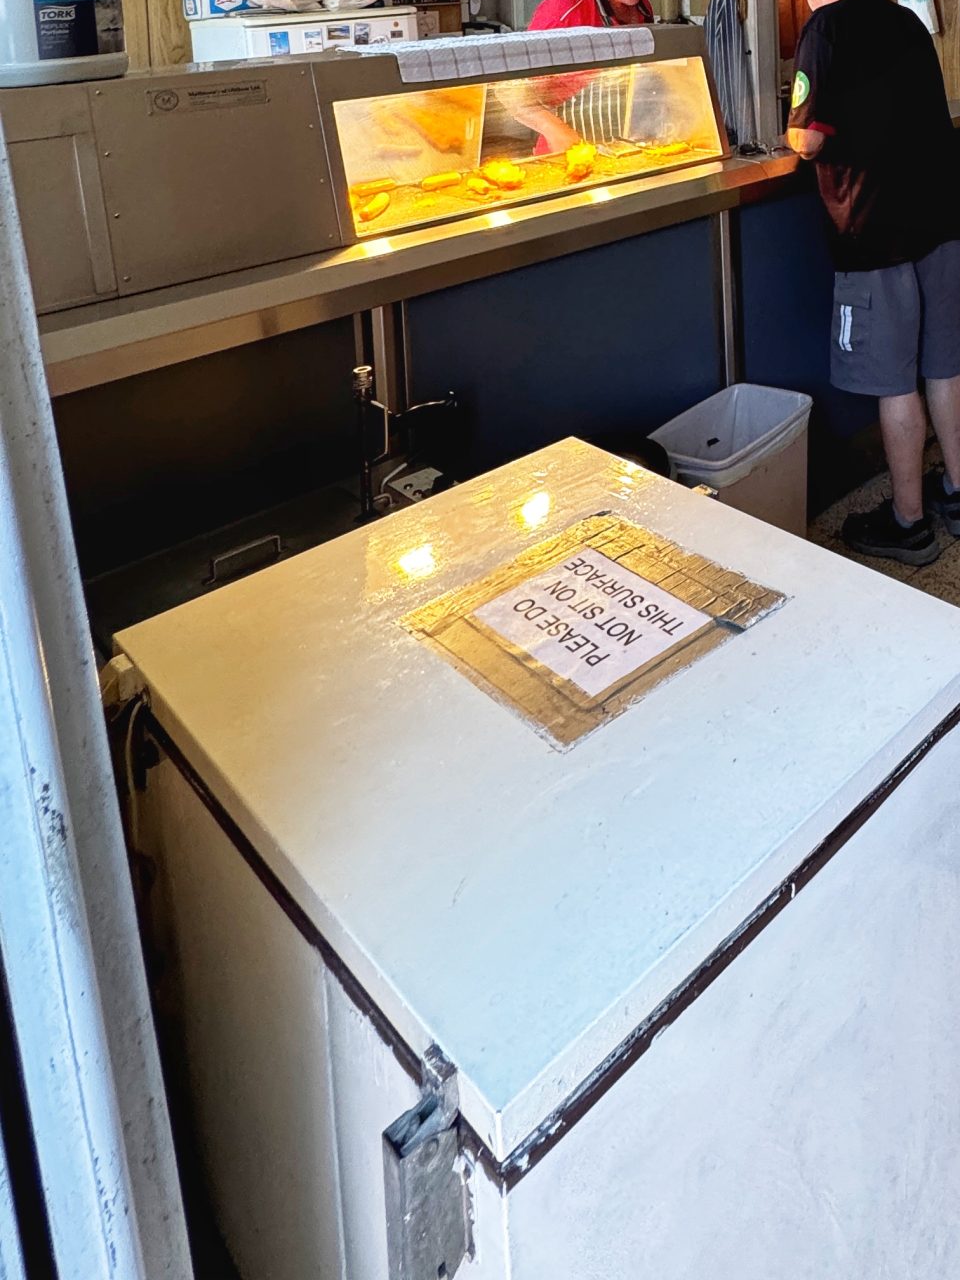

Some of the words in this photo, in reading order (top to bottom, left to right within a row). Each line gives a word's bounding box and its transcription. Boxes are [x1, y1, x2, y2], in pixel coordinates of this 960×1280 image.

[41, 10, 74, 20] TORK
[543, 579, 579, 602] ON
[563, 557, 646, 609] SURFACE
[513, 598, 547, 621] DO
[567, 598, 604, 620] SIT
[637, 603, 685, 637] THIS
[535, 614, 612, 667] PLEASE
[593, 617, 643, 647] NOT
